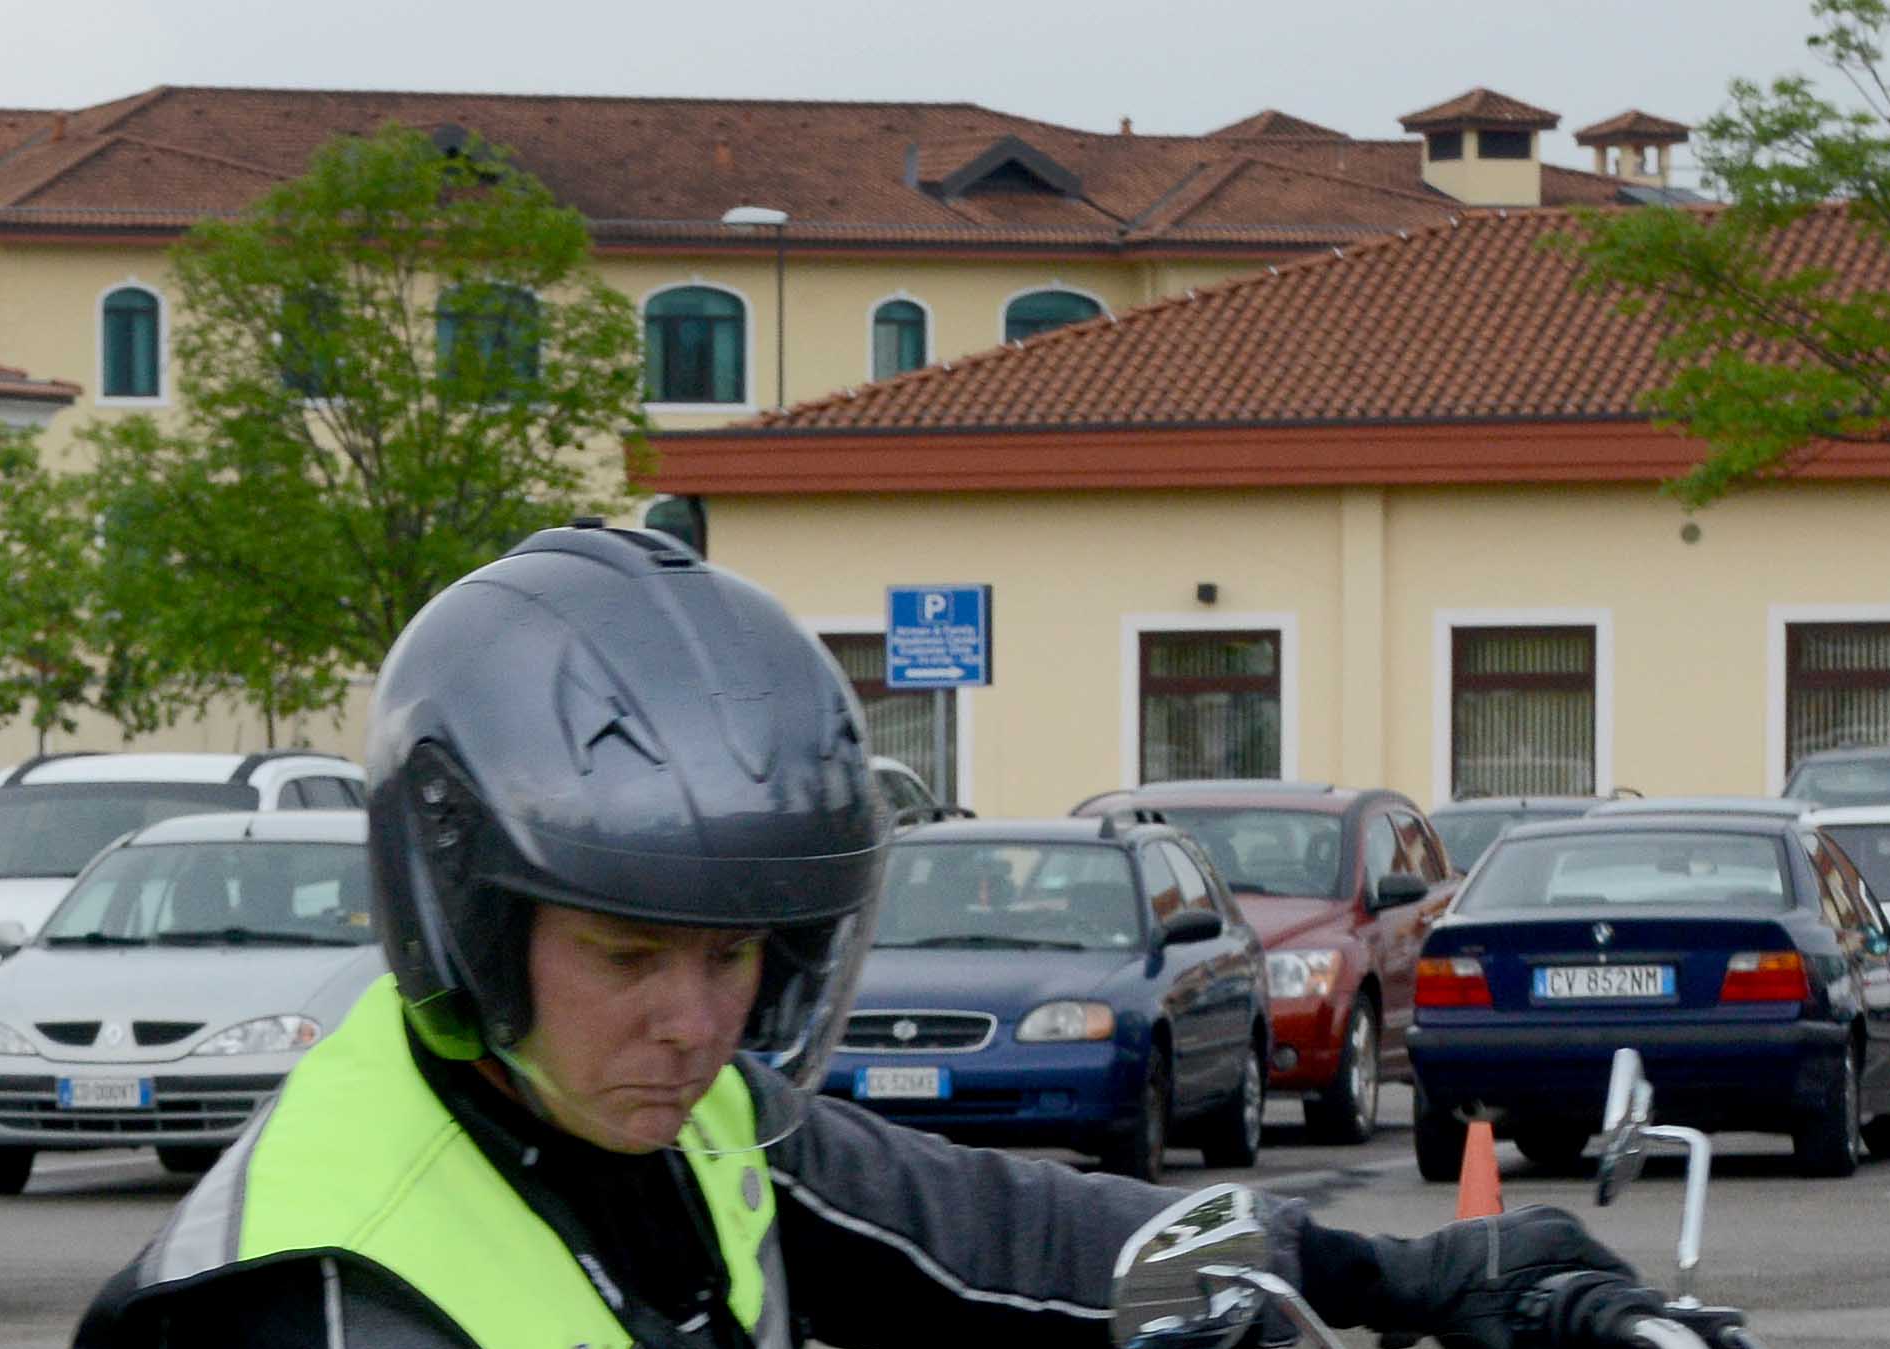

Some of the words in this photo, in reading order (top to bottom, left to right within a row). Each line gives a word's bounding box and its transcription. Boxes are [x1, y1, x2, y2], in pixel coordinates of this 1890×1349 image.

[925, 594, 947, 619] P
[1550, 968, 1577, 997] CV
[1587, 966, 1658, 995] 852NM
